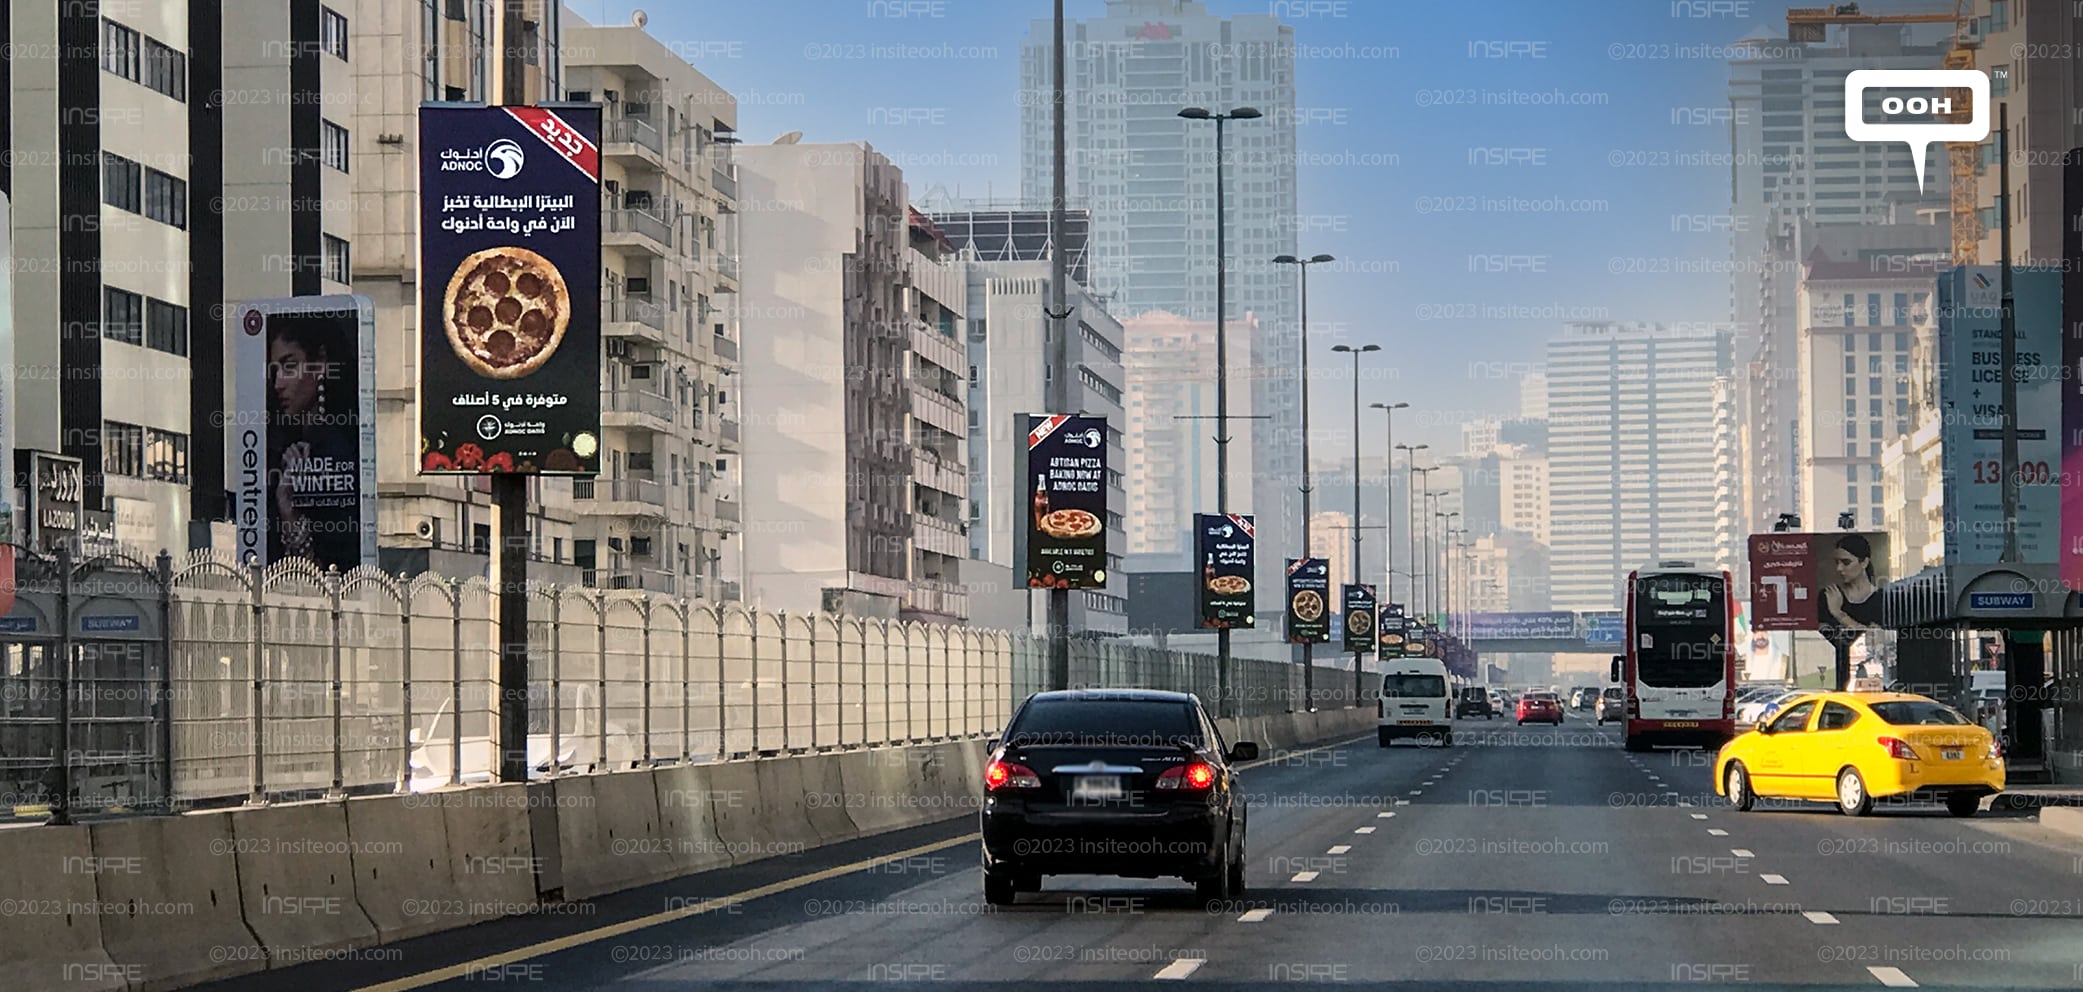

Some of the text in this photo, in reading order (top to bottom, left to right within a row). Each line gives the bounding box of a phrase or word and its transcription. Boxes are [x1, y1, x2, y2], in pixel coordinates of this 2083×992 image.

[541, 119, 583, 157] جديد
[441, 161, 483, 171] ADNOC
[442, 194, 574, 212] البيتزا الإيطالية تخبز
[441, 214, 484, 234] أدنوك
[486, 216, 520, 234] واحة
[523, 216, 547, 236] في
[1972, 352, 2041, 366] BUSESS
[1972, 369, 2029, 383] LICESE
[452, 391, 568, 411] متوفرة في 5 أصناف
[1972, 404, 2005, 418] VISA
[1034, 419, 1054, 440] NEW
[290, 457, 354, 473] MADE FOR
[1050, 457, 1101, 468] ARTISAN PIZZA
[1049, 469, 1101, 480] BAKING NOW AT
[1972, 461, 2050, 485] 1300
[291, 475, 355, 492] WINTER
[1977, 597, 2026, 606] SUBWAY
